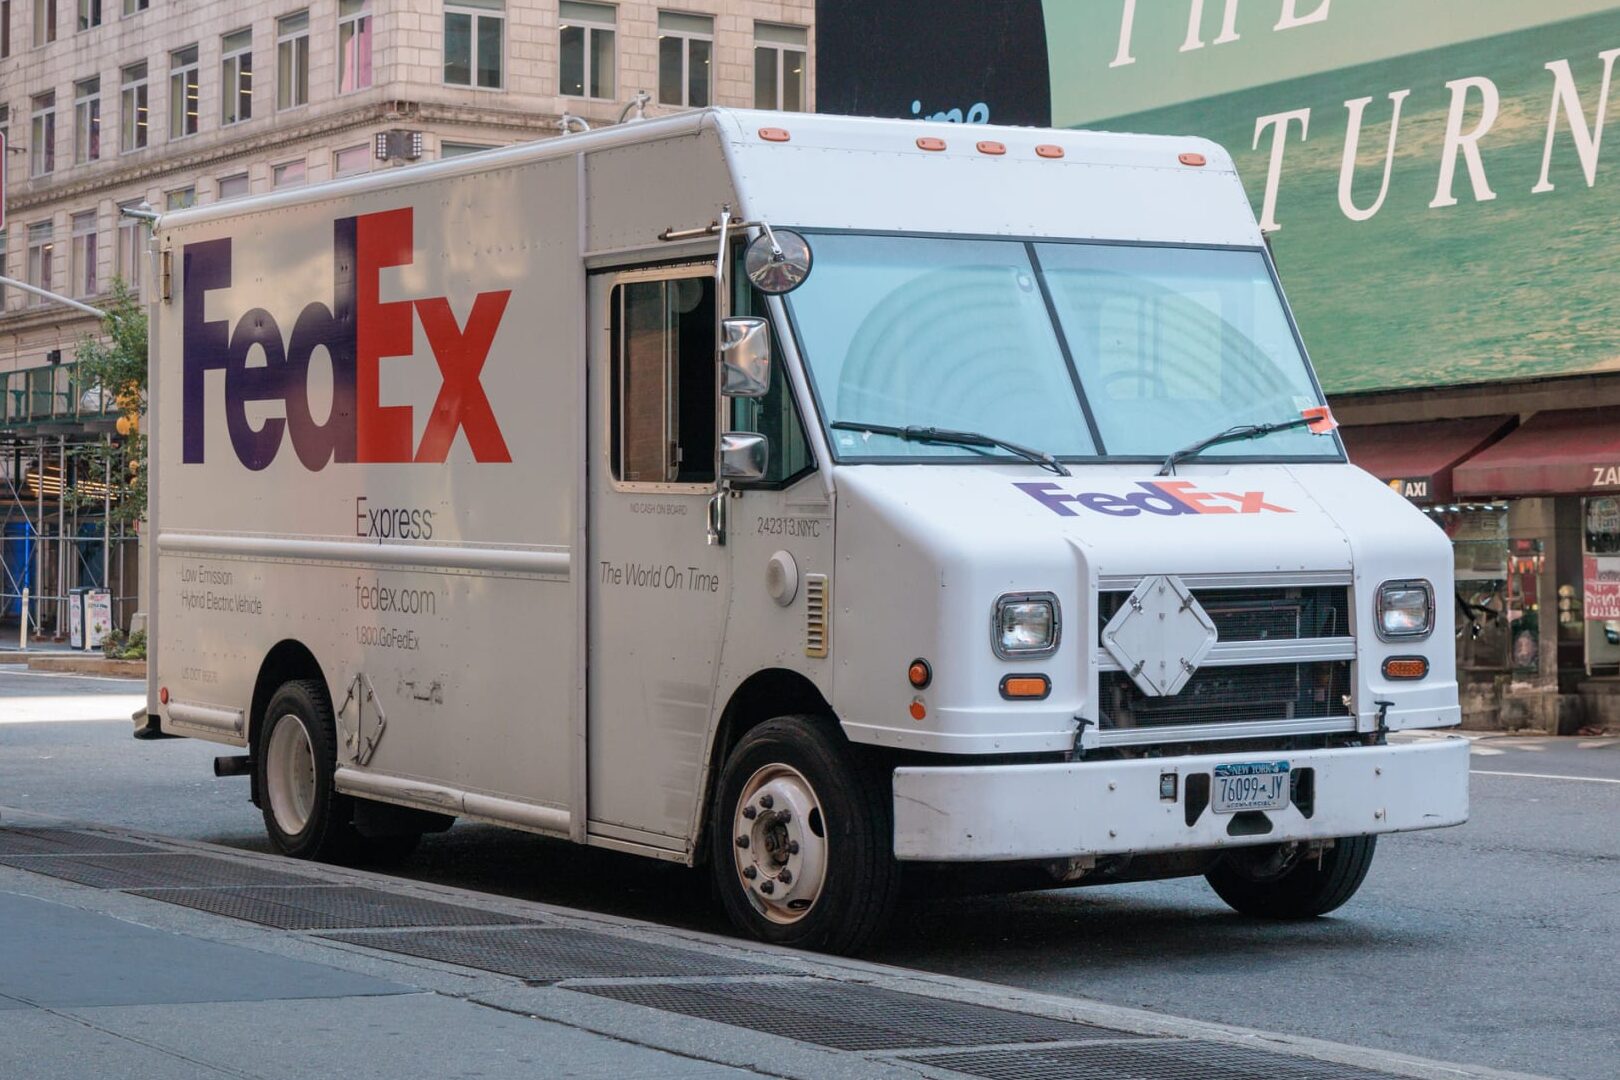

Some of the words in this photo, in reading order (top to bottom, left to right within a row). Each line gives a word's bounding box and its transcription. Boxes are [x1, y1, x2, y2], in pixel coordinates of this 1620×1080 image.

[1253, 50, 1620, 233] TURN
[183, 207, 512, 471] FedEx
[1012, 481, 1297, 516] FedEx
[356, 496, 432, 544] Express
[181, 561, 198, 582] Low
[199, 565, 233, 586] Emission
[600, 561, 622, 585] The
[625, 562, 662, 588] World
[664, 565, 683, 589] On
[687, 566, 719, 593] Time
[181, 590, 206, 611] Hybrid
[206, 591, 234, 612] Electric
[234, 593, 262, 615] Vehicle
[355, 577, 436, 615] fedex.com
[356, 625, 420, 651] 1.800.GoFedEx
